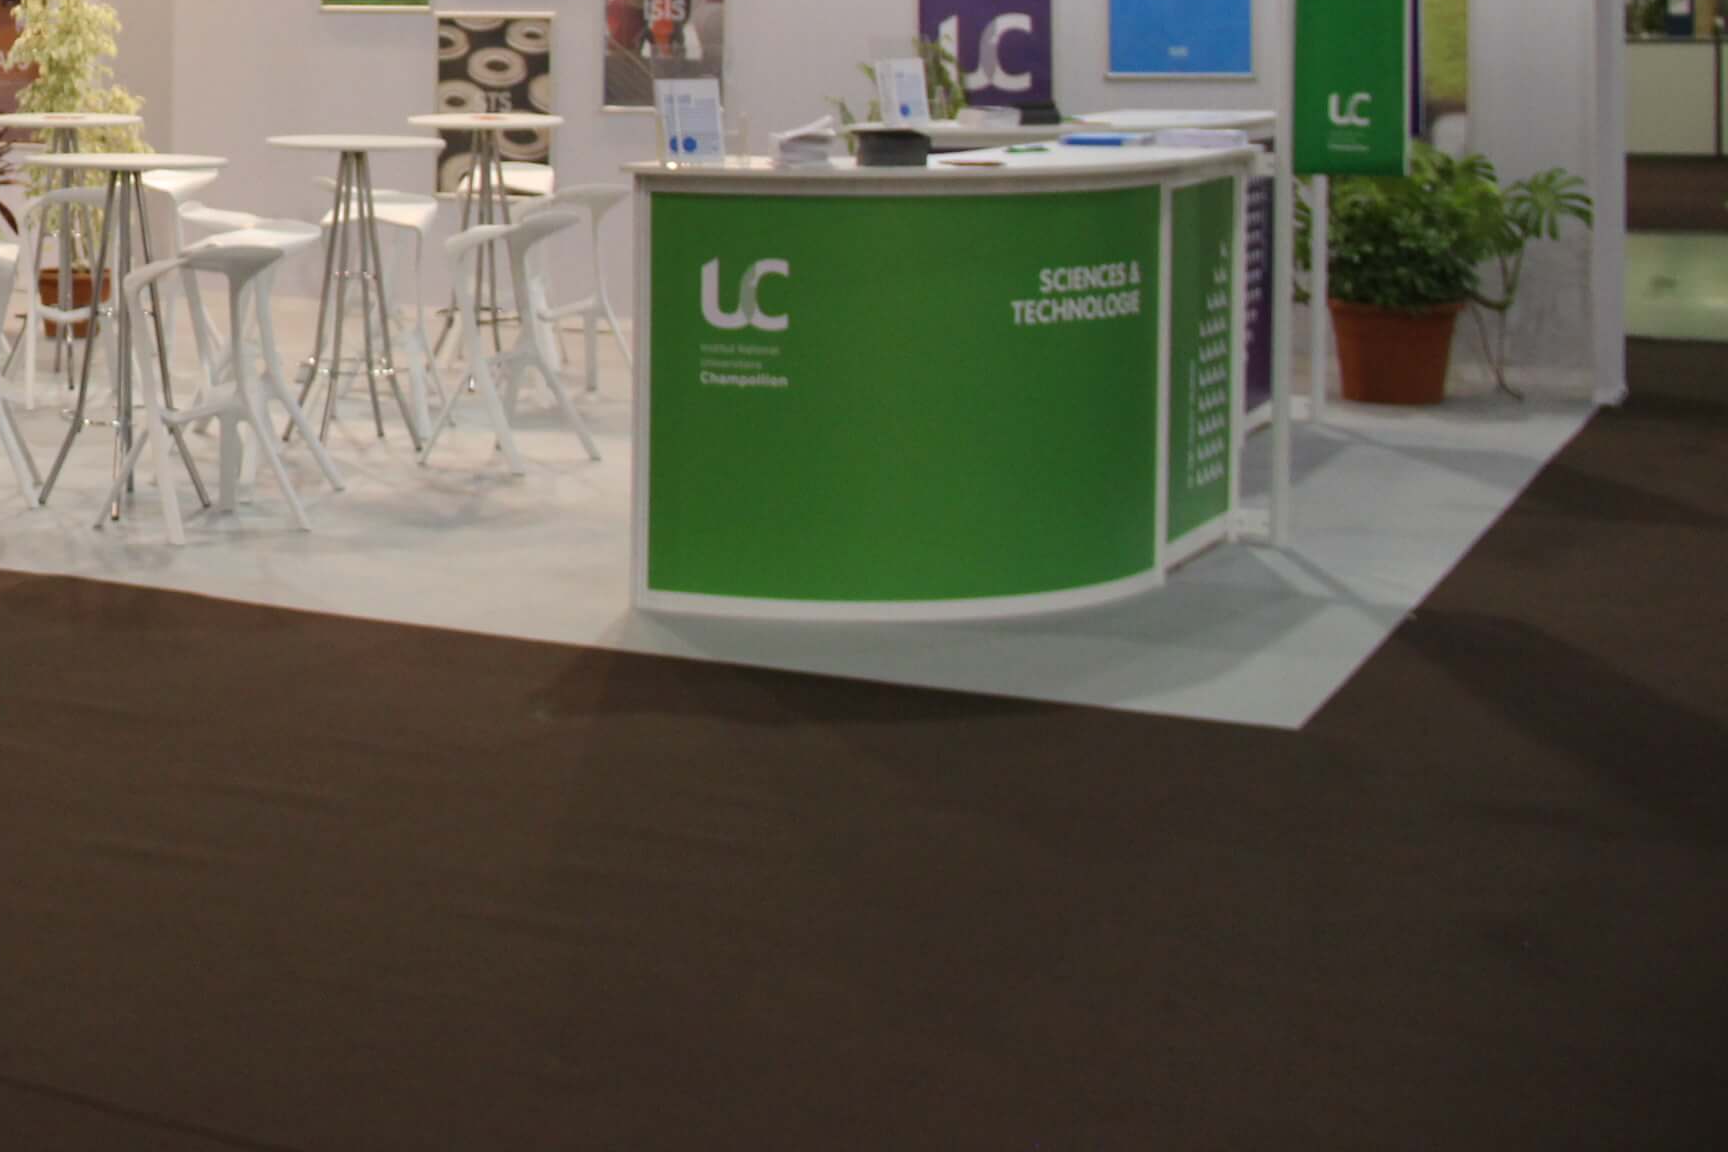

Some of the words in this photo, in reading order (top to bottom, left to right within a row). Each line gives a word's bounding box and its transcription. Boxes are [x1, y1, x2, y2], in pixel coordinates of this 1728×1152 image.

[1039, 261, 1125, 293] SCIENCES
[1129, 259, 1141, 285] &
[701, 257, 789, 331] UC
[1010, 290, 1140, 326] TECHNOLOGIE
[700, 370, 789, 388] Champollion
